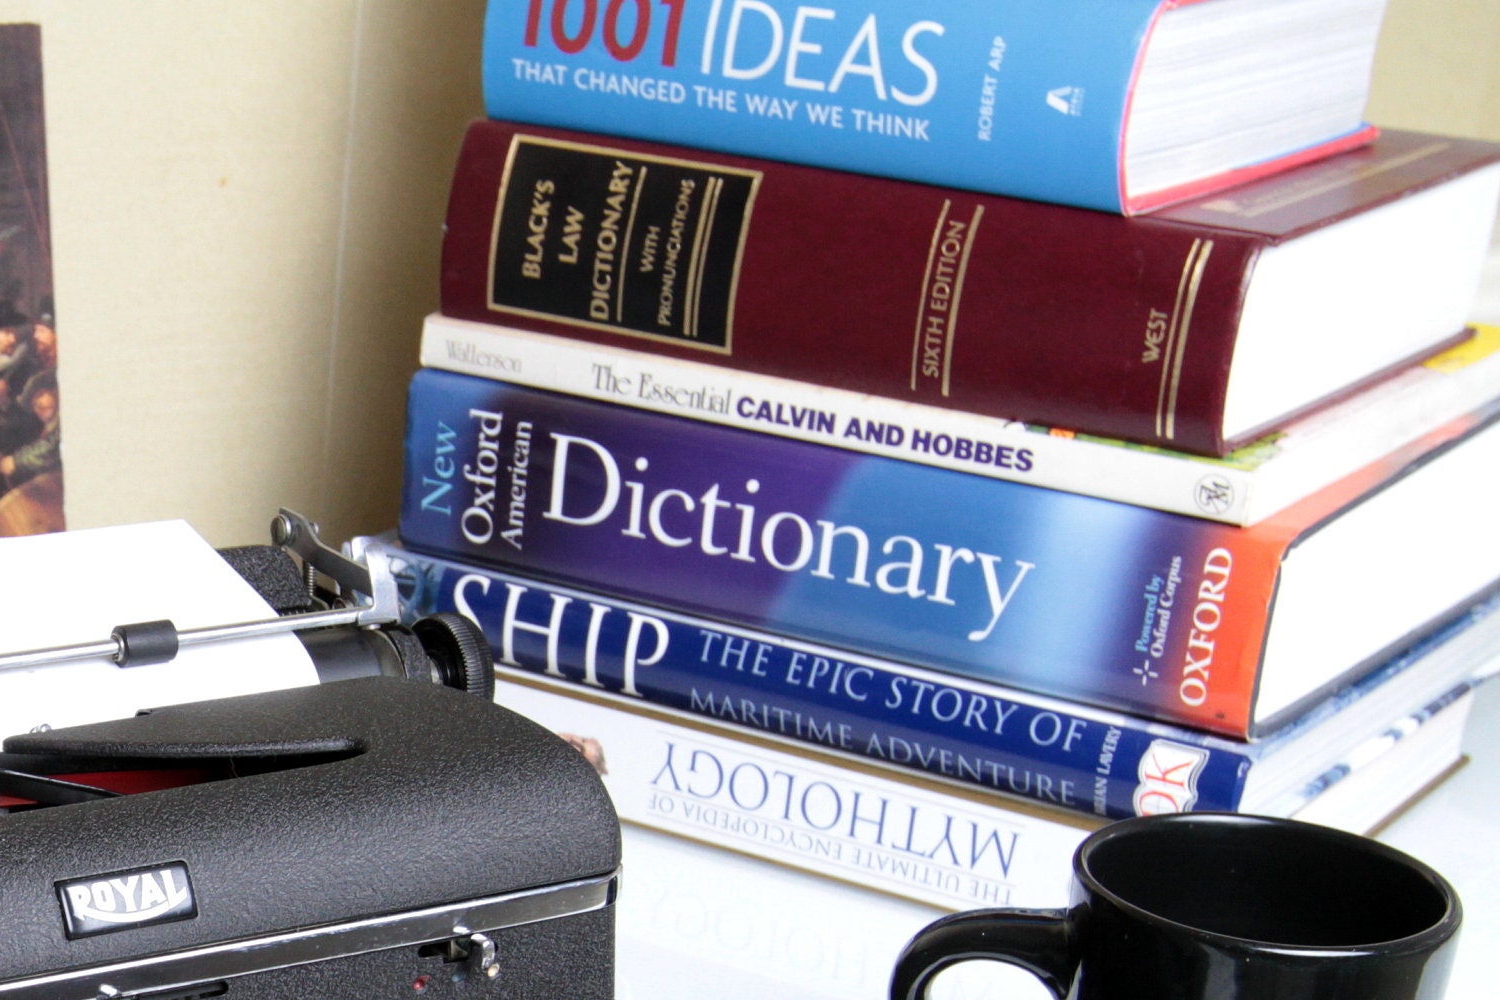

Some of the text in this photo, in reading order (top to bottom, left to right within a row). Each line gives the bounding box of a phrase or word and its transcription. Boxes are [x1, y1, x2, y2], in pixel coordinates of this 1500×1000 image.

[511, 58, 931, 142] THAT CHANGED THE WAY WE THINK
[523, 0, 946, 106] 1001 IDEAS
[977, 36, 1007, 142] ROBERT ARP
[521, 178, 556, 280] BLACK'S
[558, 205, 581, 265] LAW
[589, 160, 635, 322] DICTIONARY
[639, 225, 661, 273] WITH
[656, 178, 697, 327] PRONUNCIATIONS
[922, 219, 966, 379] SIXTH EDITION
[1142, 306, 1169, 364] WEST
[420, 420, 460, 517] New
[591, 362, 1035, 474] The Essential CALVIN AND HOBBES
[460, 407, 505, 546] Oxford
[499, 420, 534, 551] American
[542, 432, 1036, 643] Dictionary
[452, 572, 671, 698] SHIP
[1134, 573, 1164, 652] Powered by
[1149, 555, 1182, 658] Oxford Corpus
[1178, 546, 1233, 708] OXFORD
[698, 629, 1088, 754] THE EPIC STORY OF
[689, 686, 1077, 807] MARITIME ADVENTURE
[1096, 725, 1122, 776] LAVERY
[1138, 752, 1196, 817] DK
[648, 790, 1013, 906] THE ULTIMATE ENCYCLOPEDIA OF
[650, 741, 1020, 879] MYTHOLOGY
[66, 869, 188, 923] ROYAL
